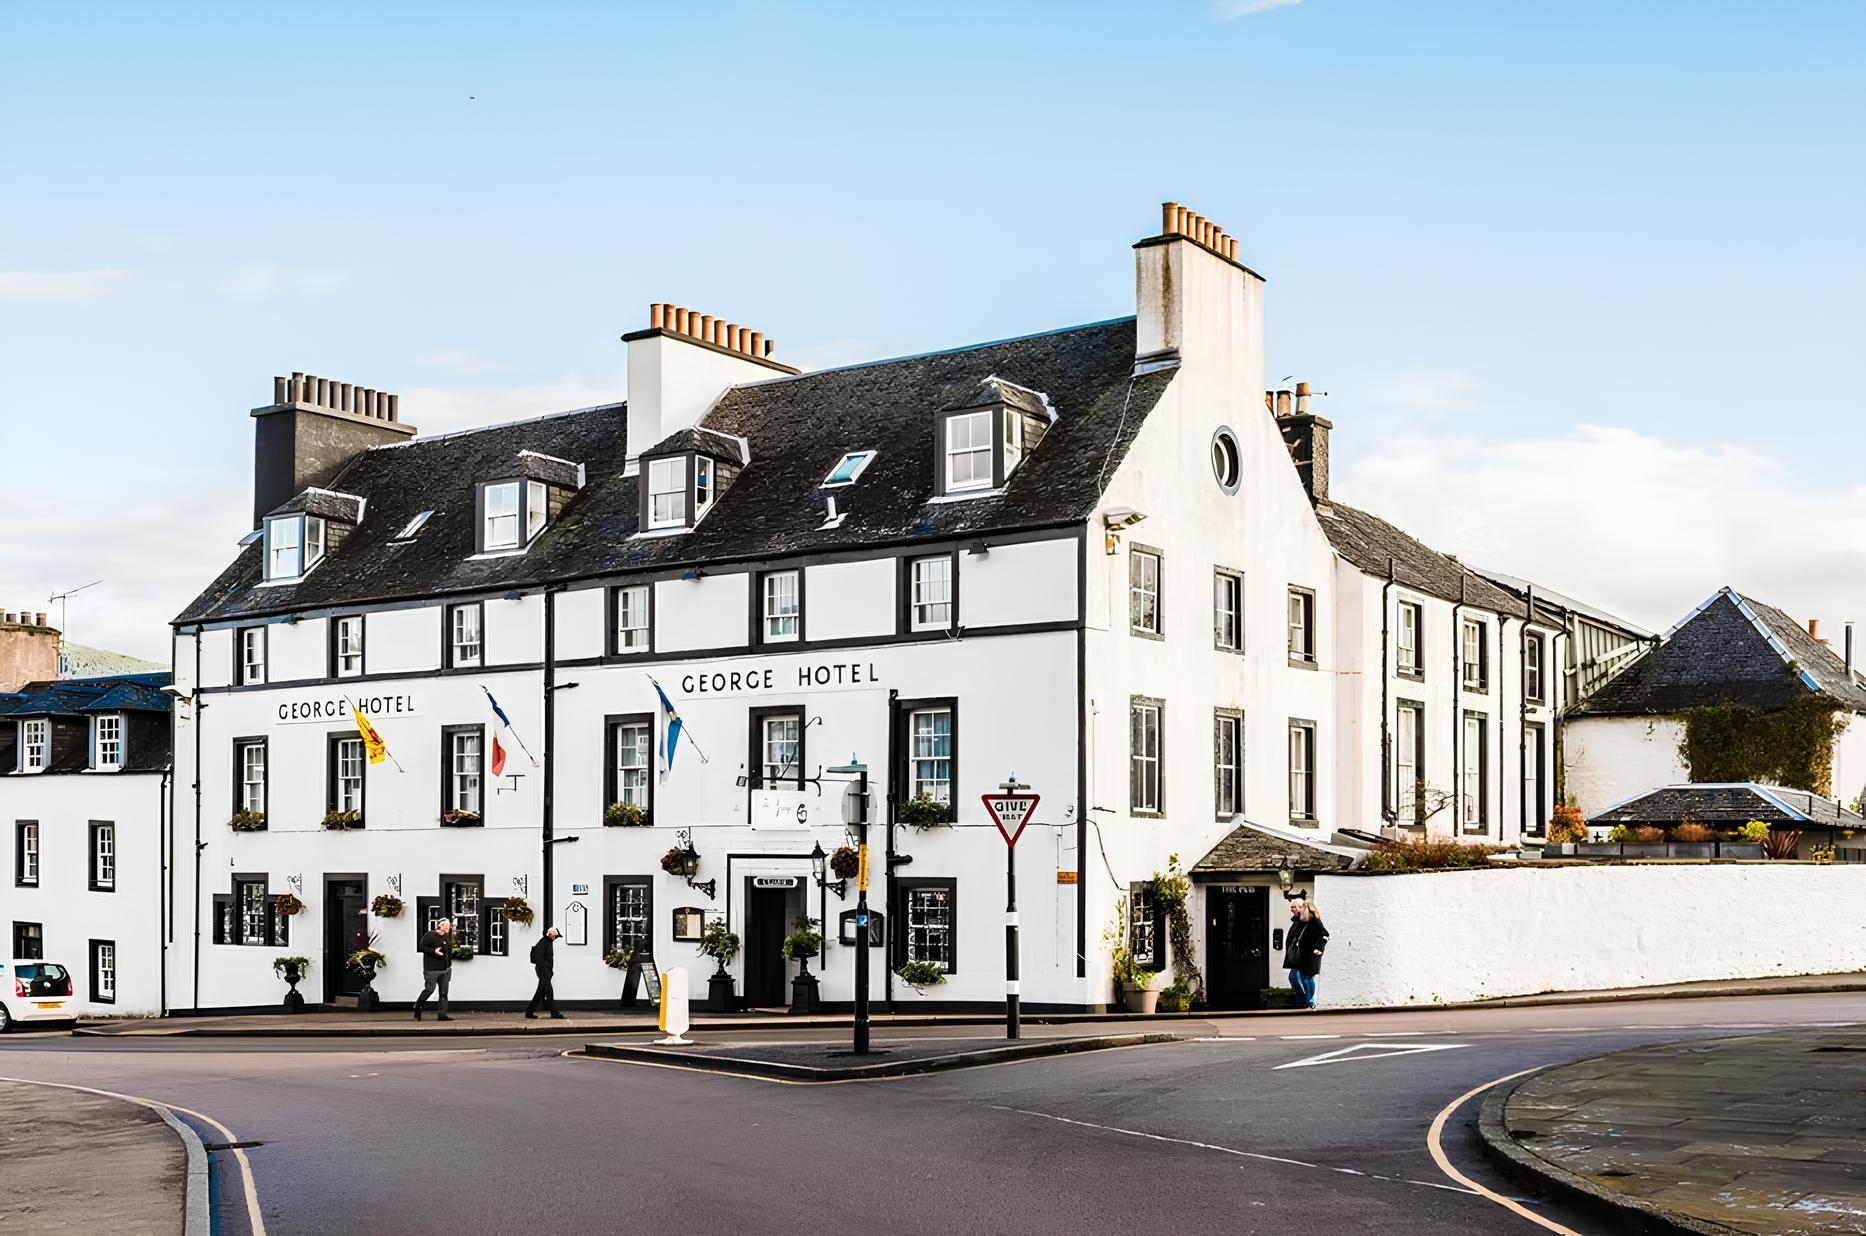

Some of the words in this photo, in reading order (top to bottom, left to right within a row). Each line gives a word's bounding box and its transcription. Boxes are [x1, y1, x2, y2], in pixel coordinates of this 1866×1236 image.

[682, 670, 773, 694] GEORGE
[798, 662, 879, 687] HOTEL
[278, 699, 346, 720] GEORGE
[358, 695, 415, 714] HOTEL
